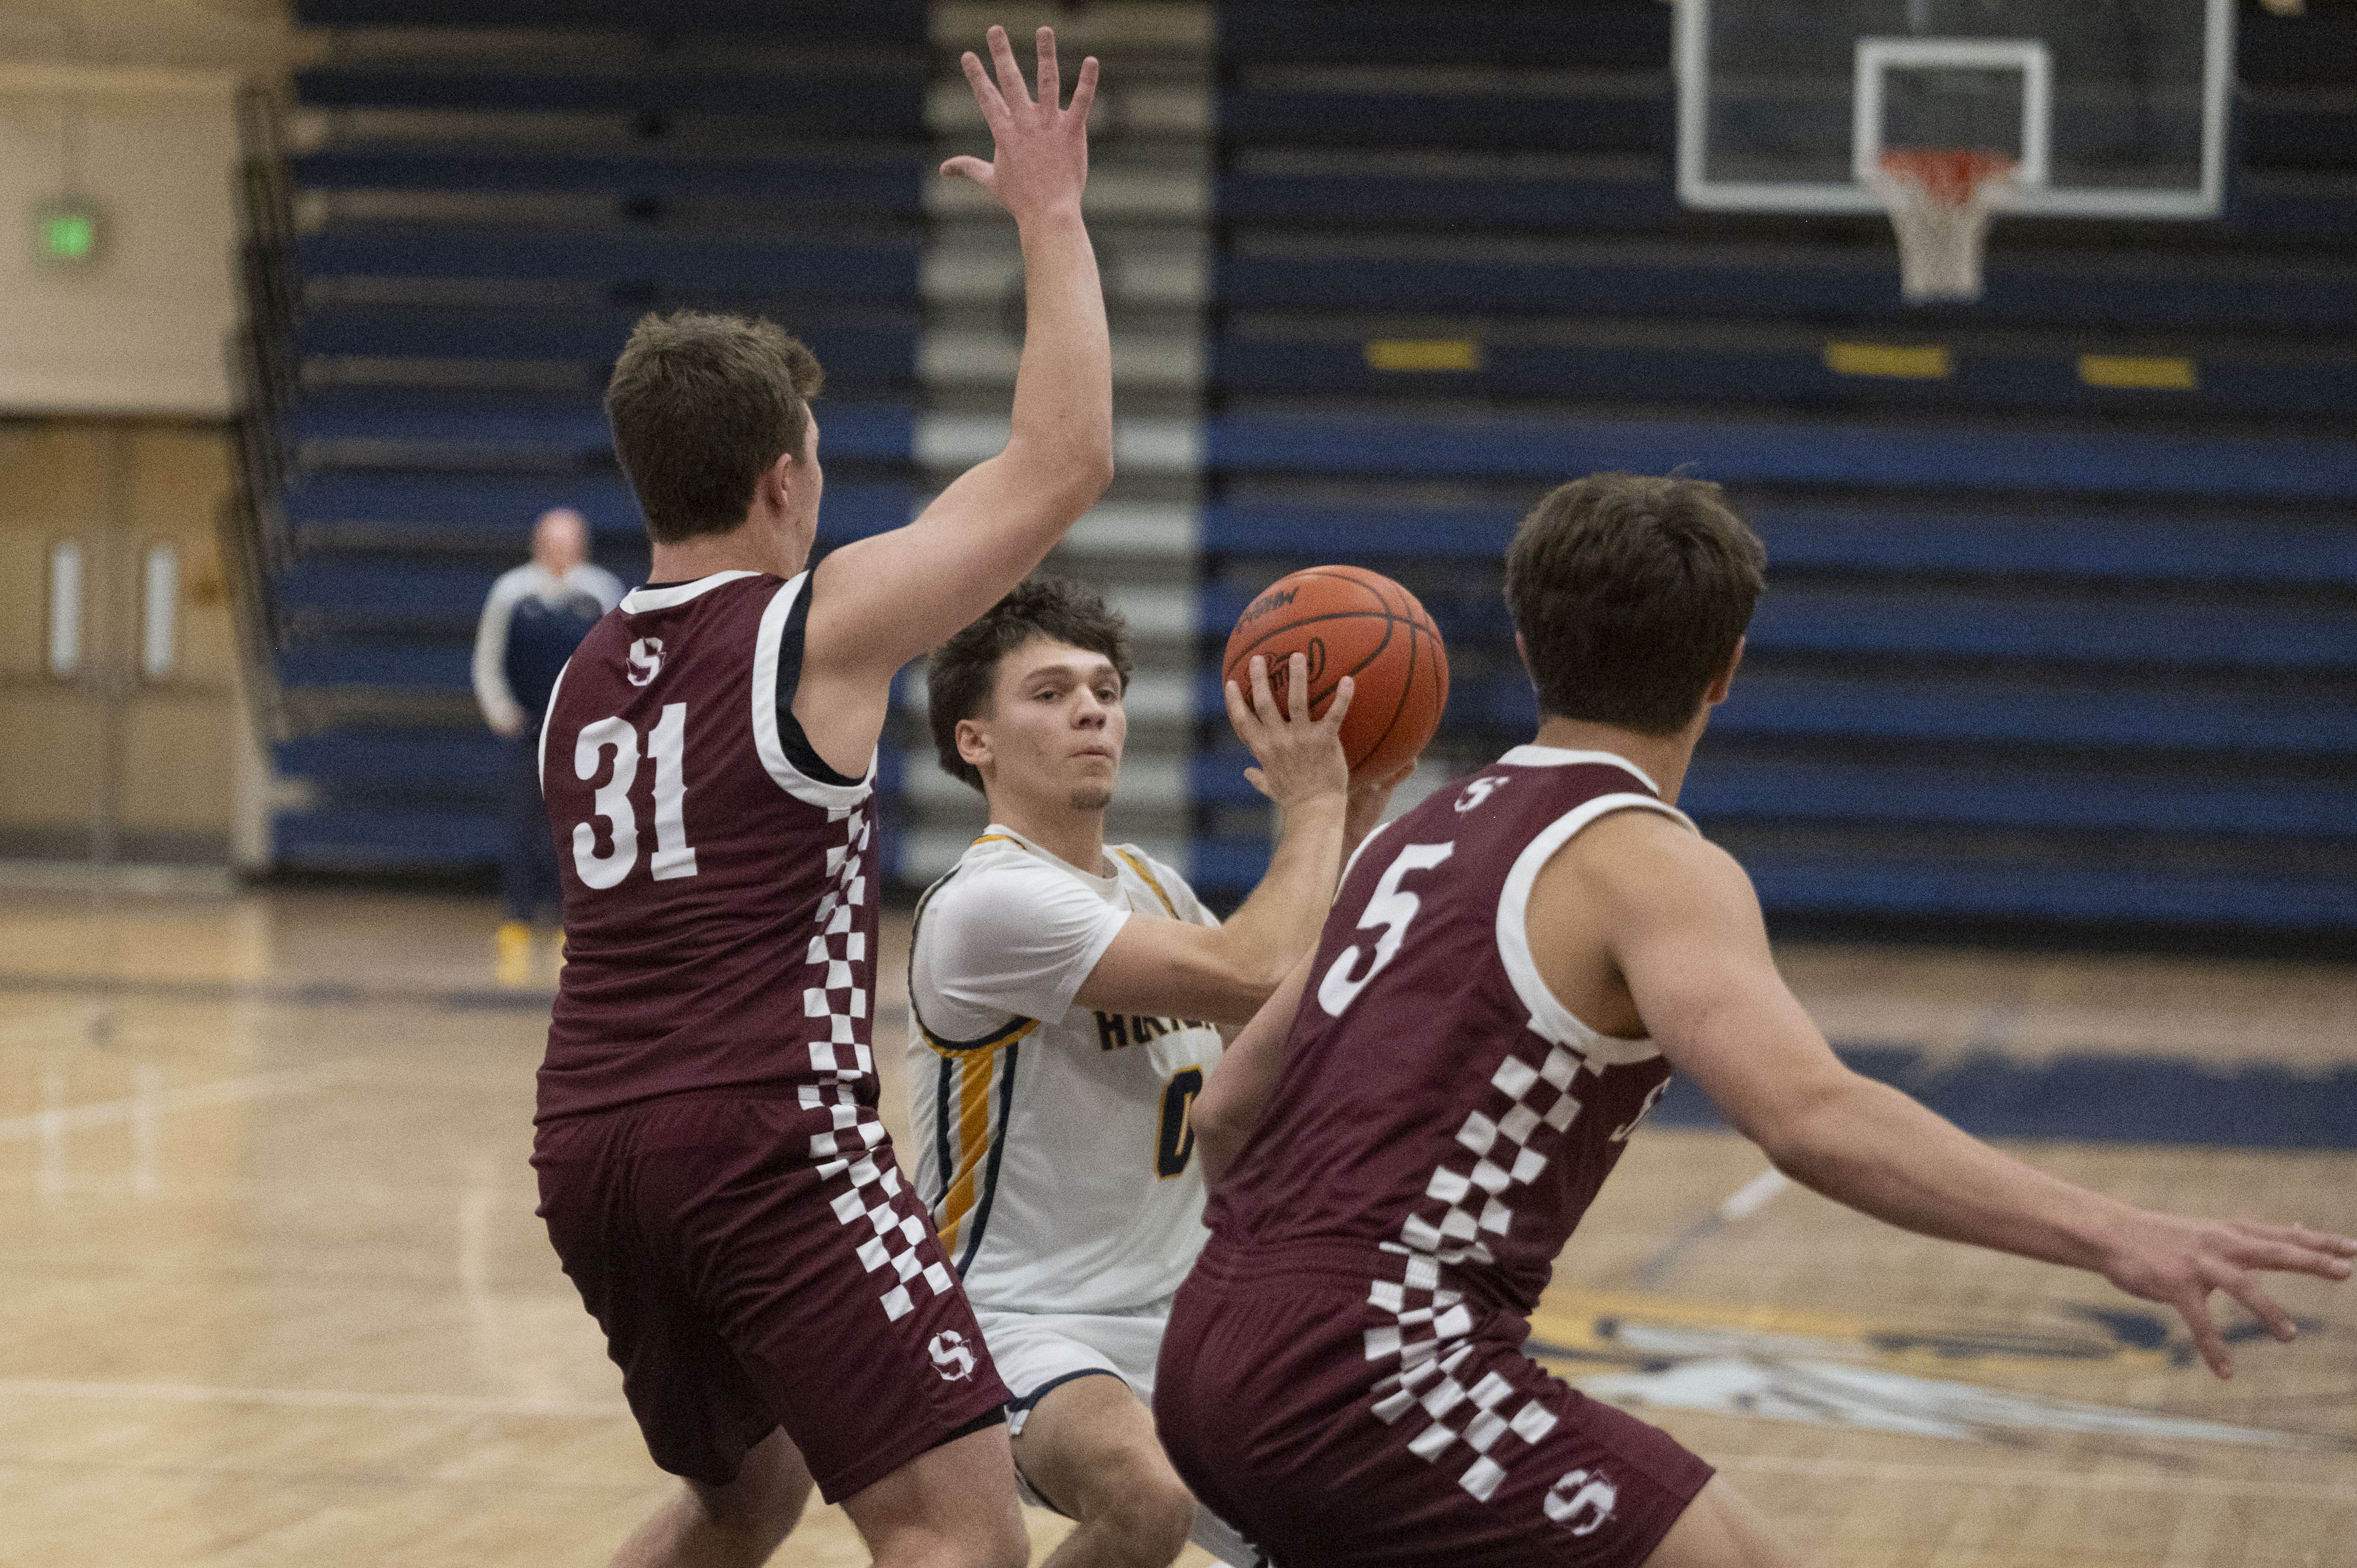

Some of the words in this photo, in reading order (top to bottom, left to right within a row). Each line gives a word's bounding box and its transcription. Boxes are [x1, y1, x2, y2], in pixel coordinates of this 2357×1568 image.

[572, 702, 698, 890] 31
[1317, 840, 1455, 1018] 5
[1154, 1064, 1203, 1181] 0
